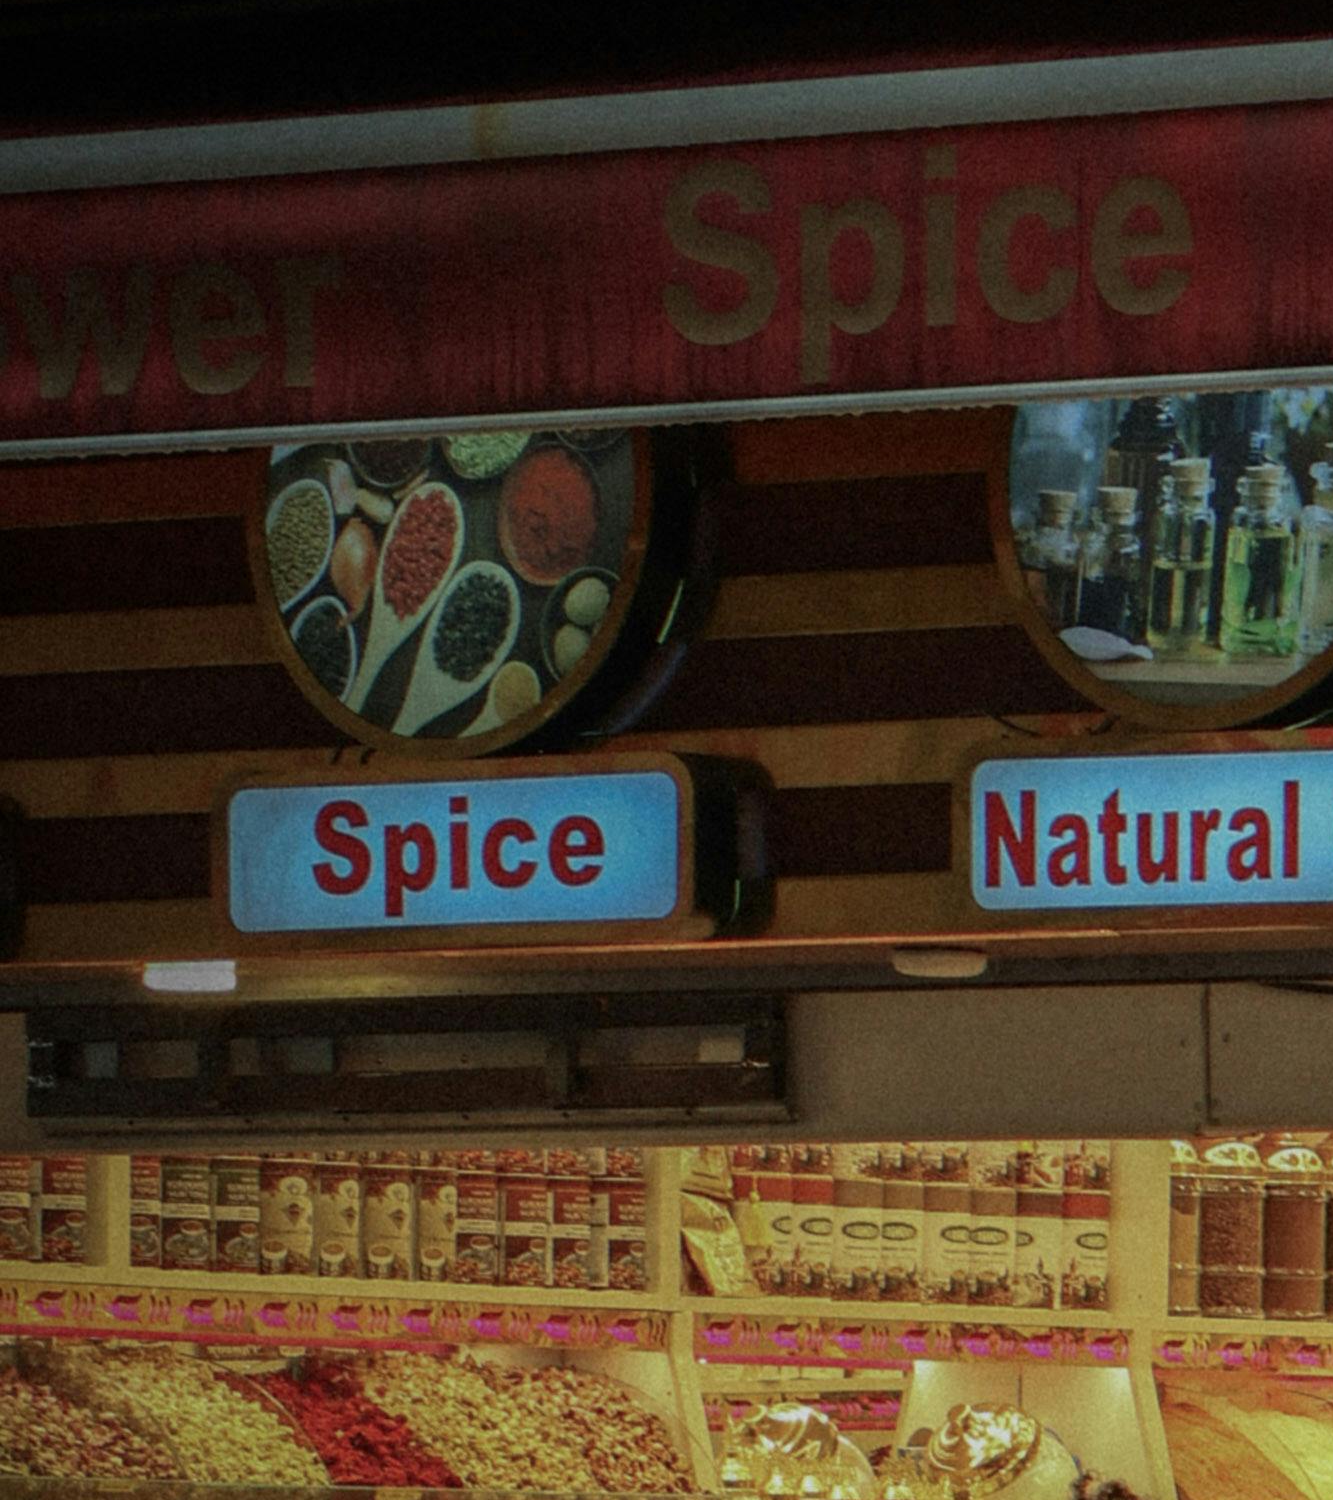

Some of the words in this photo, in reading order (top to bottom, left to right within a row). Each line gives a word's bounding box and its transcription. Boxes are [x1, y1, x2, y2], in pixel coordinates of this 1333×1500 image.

[0, 256, 345, 399] wer
[662, 146, 1193, 384] Spice
[315, 798, 604, 917] Spice
[986, 783, 1300, 888] Natural
